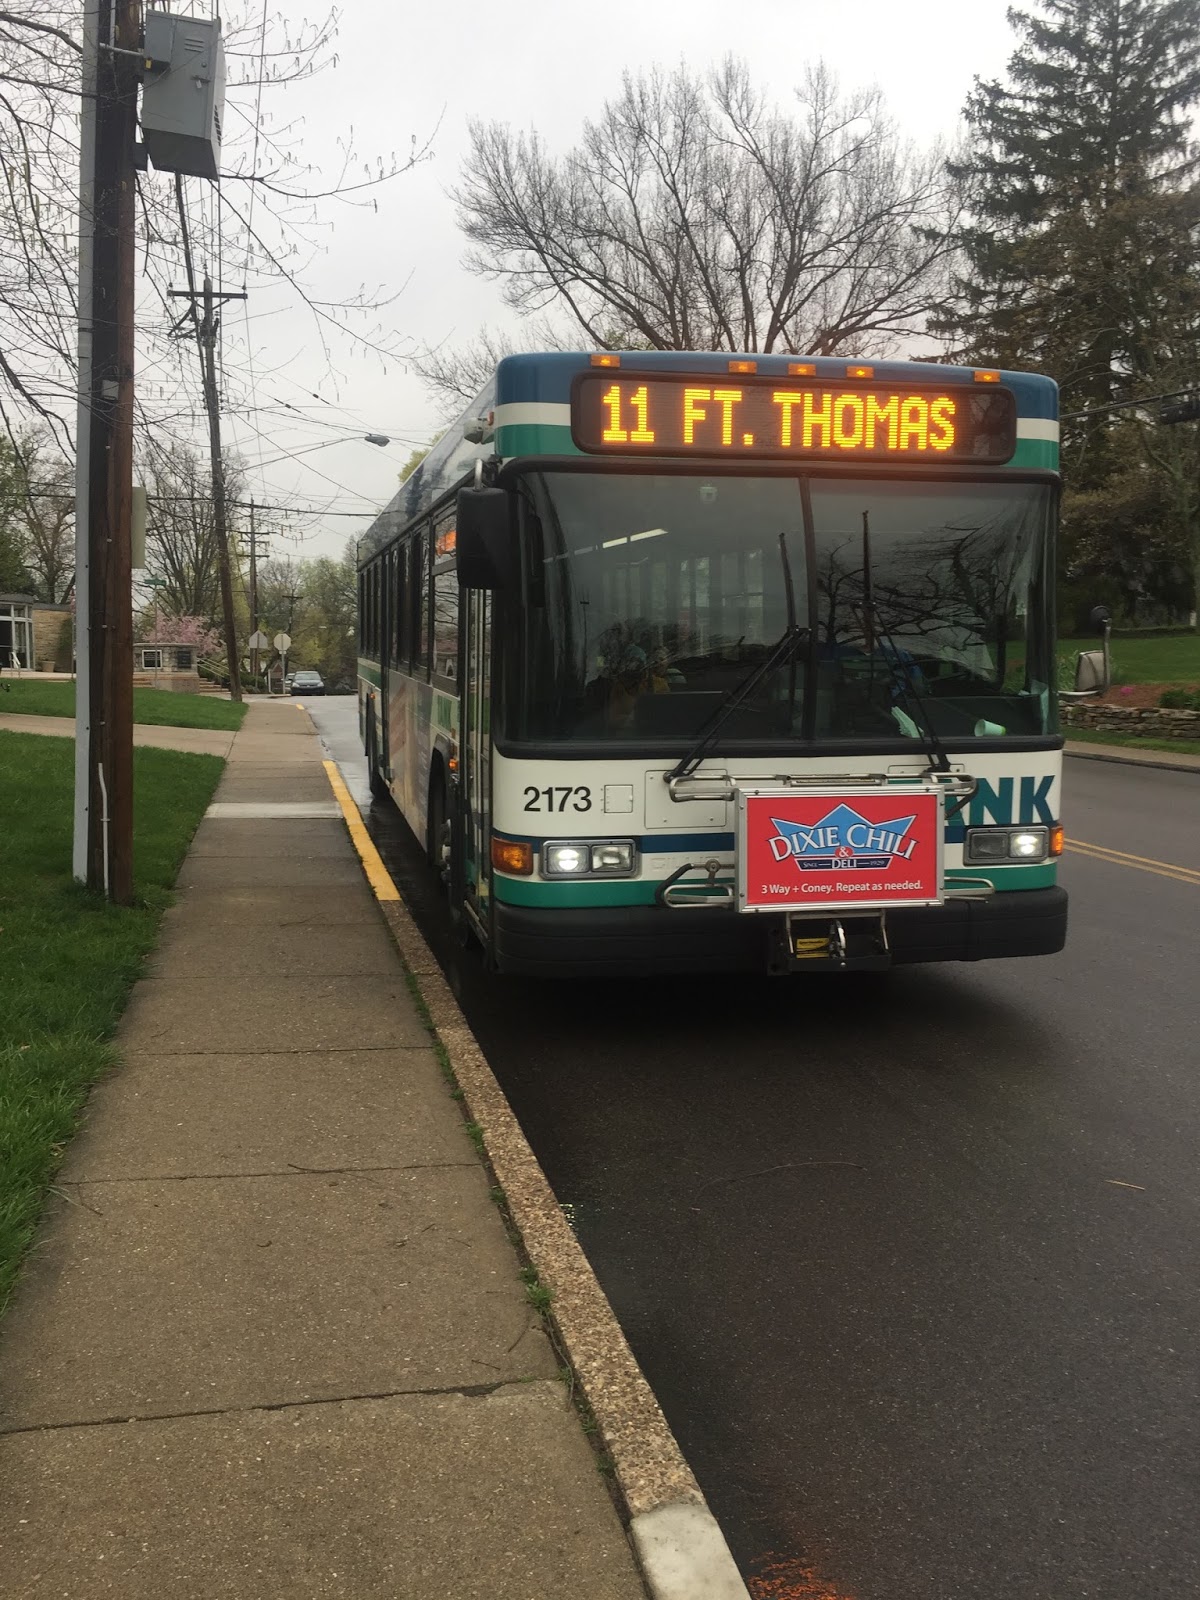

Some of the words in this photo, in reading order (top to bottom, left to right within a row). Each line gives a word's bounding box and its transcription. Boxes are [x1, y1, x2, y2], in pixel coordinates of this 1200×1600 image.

[602, 385, 655, 443] 11
[683, 388, 754, 446] FT.
[773, 391, 956, 451] THOMAS
[523, 786, 592, 812] 2173
[768, 826, 840, 862] DIXIE
[846, 823, 919, 860] CHILI
[839, 846, 850, 857] &
[831, 859, 858, 869] DELI
[761, 885, 768, 894] 3
[769, 884, 791, 895] Way
[801, 883, 834, 894] Coney.
[836, 882, 870, 894] Repeat
[872, 883, 883, 891] as
[884, 880, 923, 891] needed.
